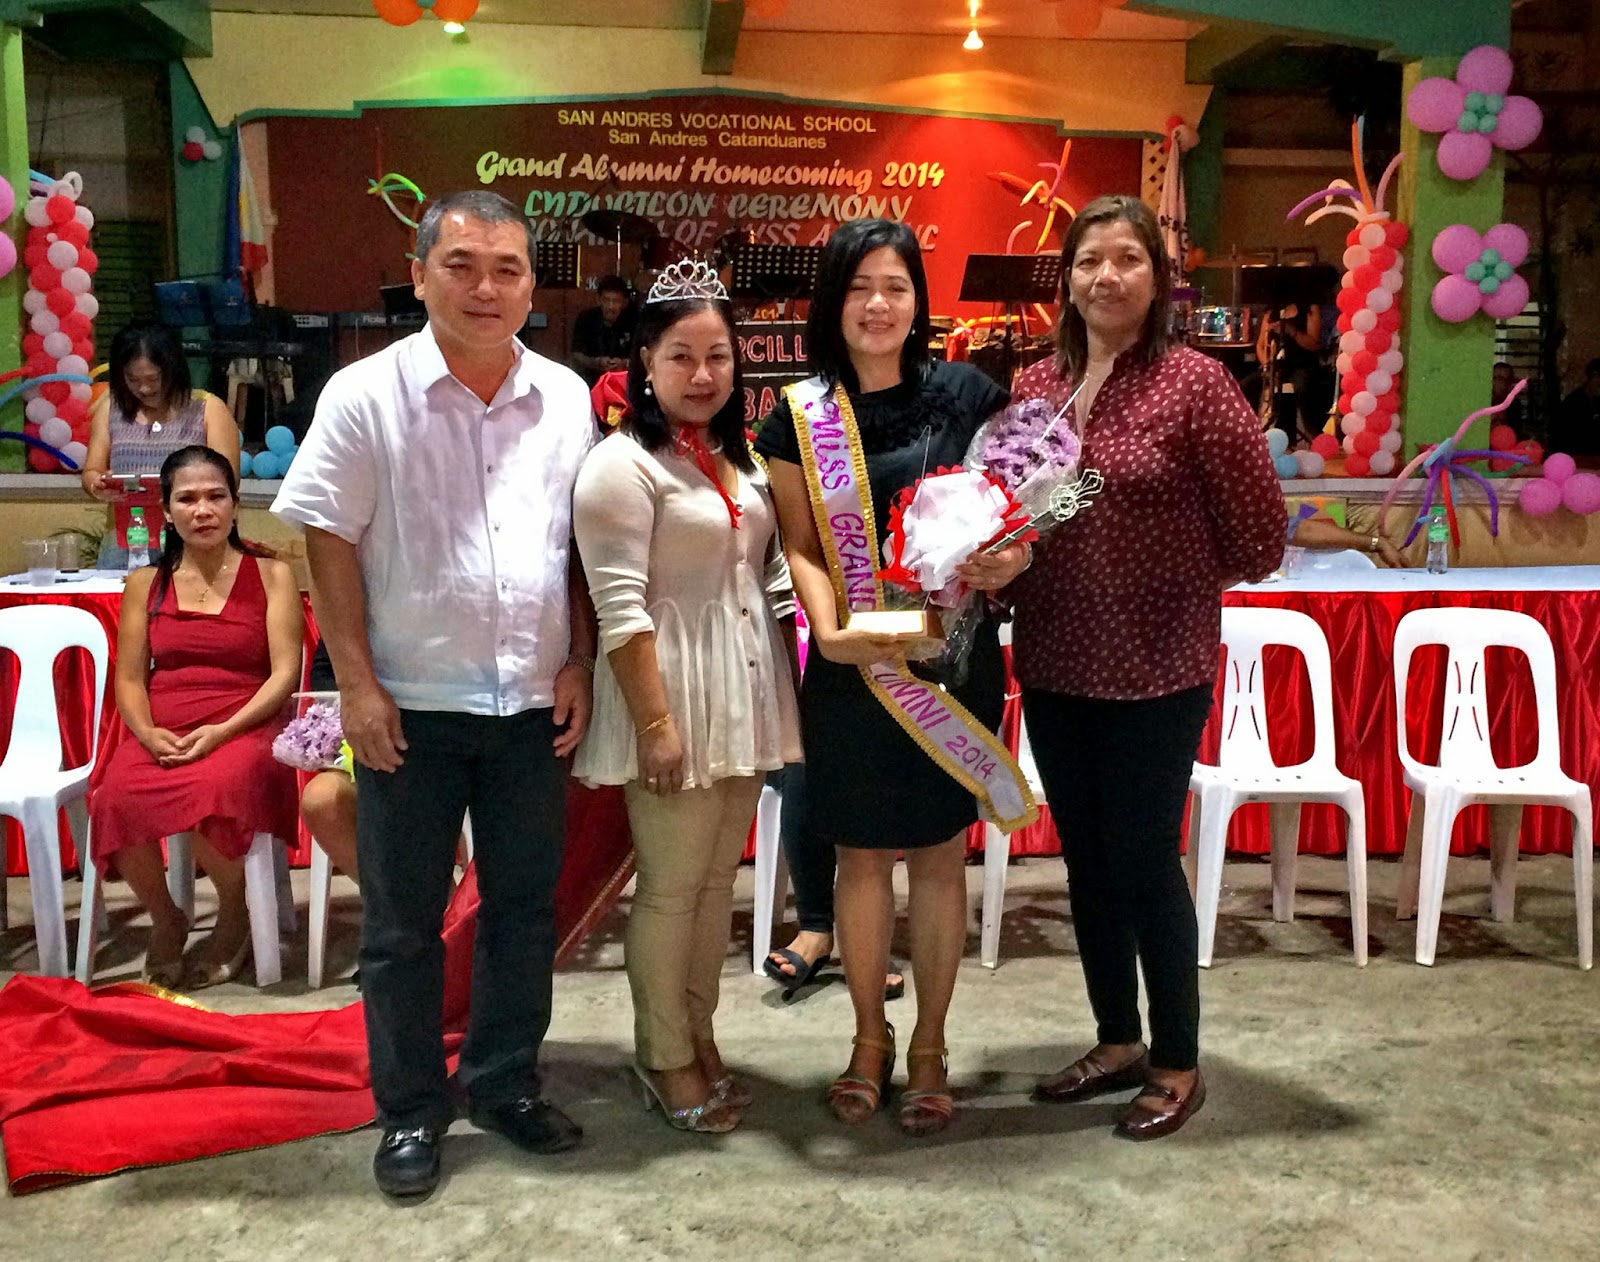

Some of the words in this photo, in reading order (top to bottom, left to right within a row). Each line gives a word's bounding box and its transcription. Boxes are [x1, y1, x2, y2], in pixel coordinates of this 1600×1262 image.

[557, 110, 595, 126] SAN
[600, 111, 673, 128] ANDRES
[680, 113, 796, 131] VOCATIONAL
[803, 116, 877, 133] SCHOOL
[608, 129, 640, 145] San
[649, 131, 708, 147] Andres
[718, 132, 827, 149] Catanduanes
[475, 150, 567, 185] Grand
[568, 153, 687, 182] Alumni
[689, 156, 873, 197] Homecoming
[881, 161, 945, 188] 2014
[362, 314, 398, 324] Rolad
[945, 735, 997, 780] 2014
